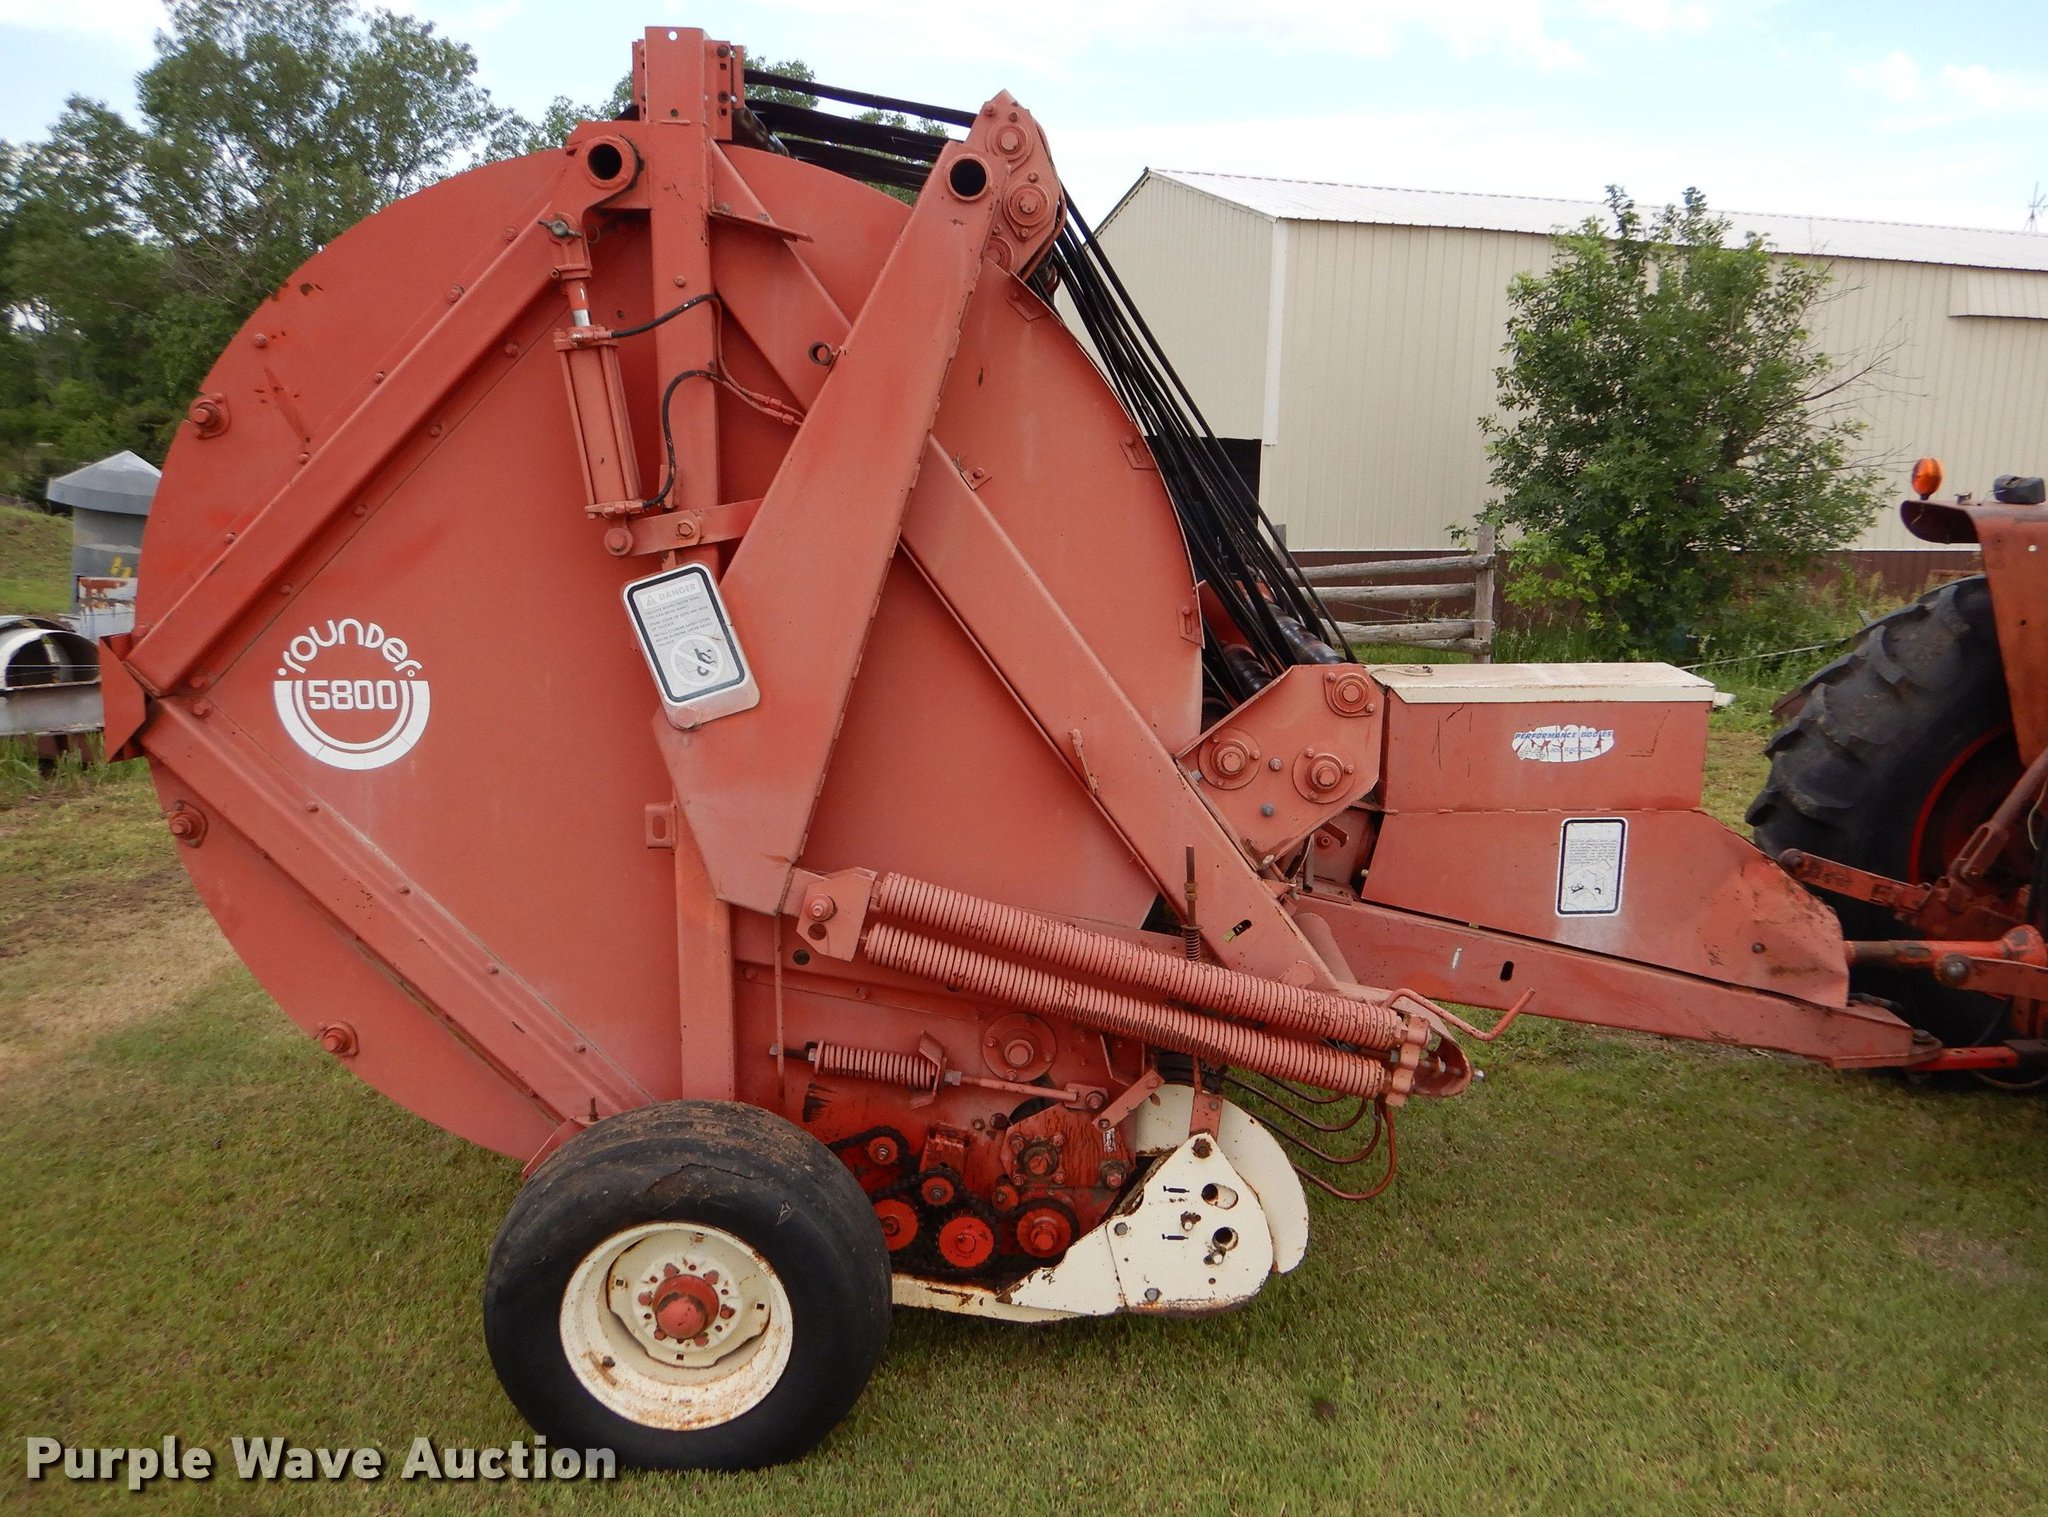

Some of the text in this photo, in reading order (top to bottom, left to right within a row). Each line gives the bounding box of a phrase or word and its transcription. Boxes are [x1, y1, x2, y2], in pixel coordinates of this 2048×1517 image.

[658, 583, 696, 601] DANGER
[308, 680, 398, 710] 5800
[1515, 732, 1578, 740] PERFORMANCE
